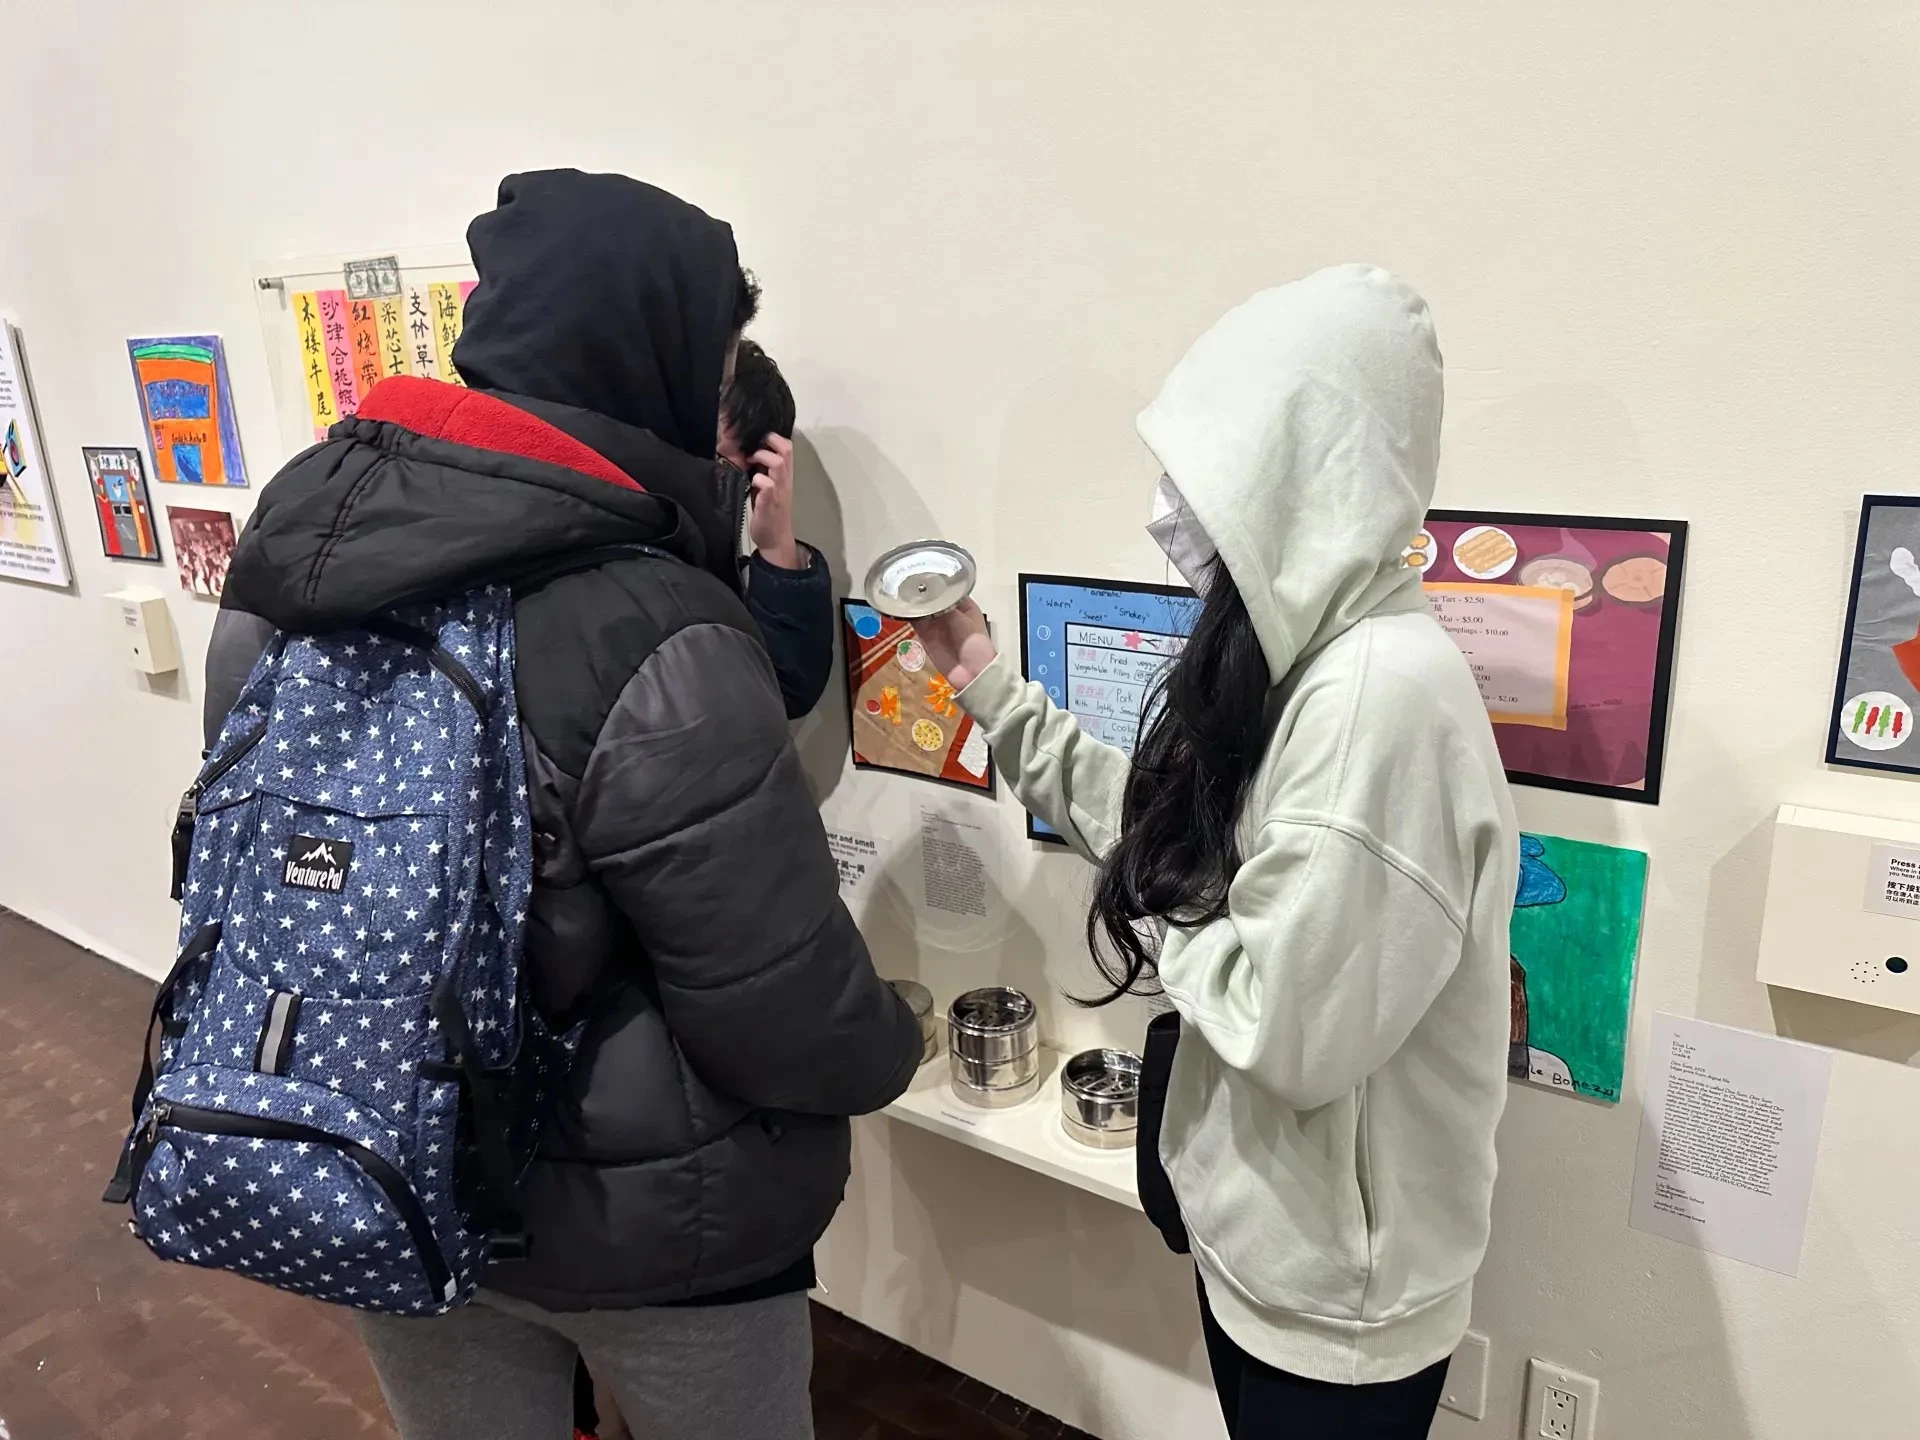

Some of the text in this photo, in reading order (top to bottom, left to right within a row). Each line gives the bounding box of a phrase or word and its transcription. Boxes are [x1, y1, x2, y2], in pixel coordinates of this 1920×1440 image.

[1464, 596, 1485, 605] $2.50
[1462, 616, 1484, 625] $5.00
[1485, 628, 1509, 637] $10.00
[1079, 631, 1114, 647] MENU
[854, 839, 875, 849] smell
[1891, 858, 1916, 868] Press
[285, 860, 344, 890] VenturePal
